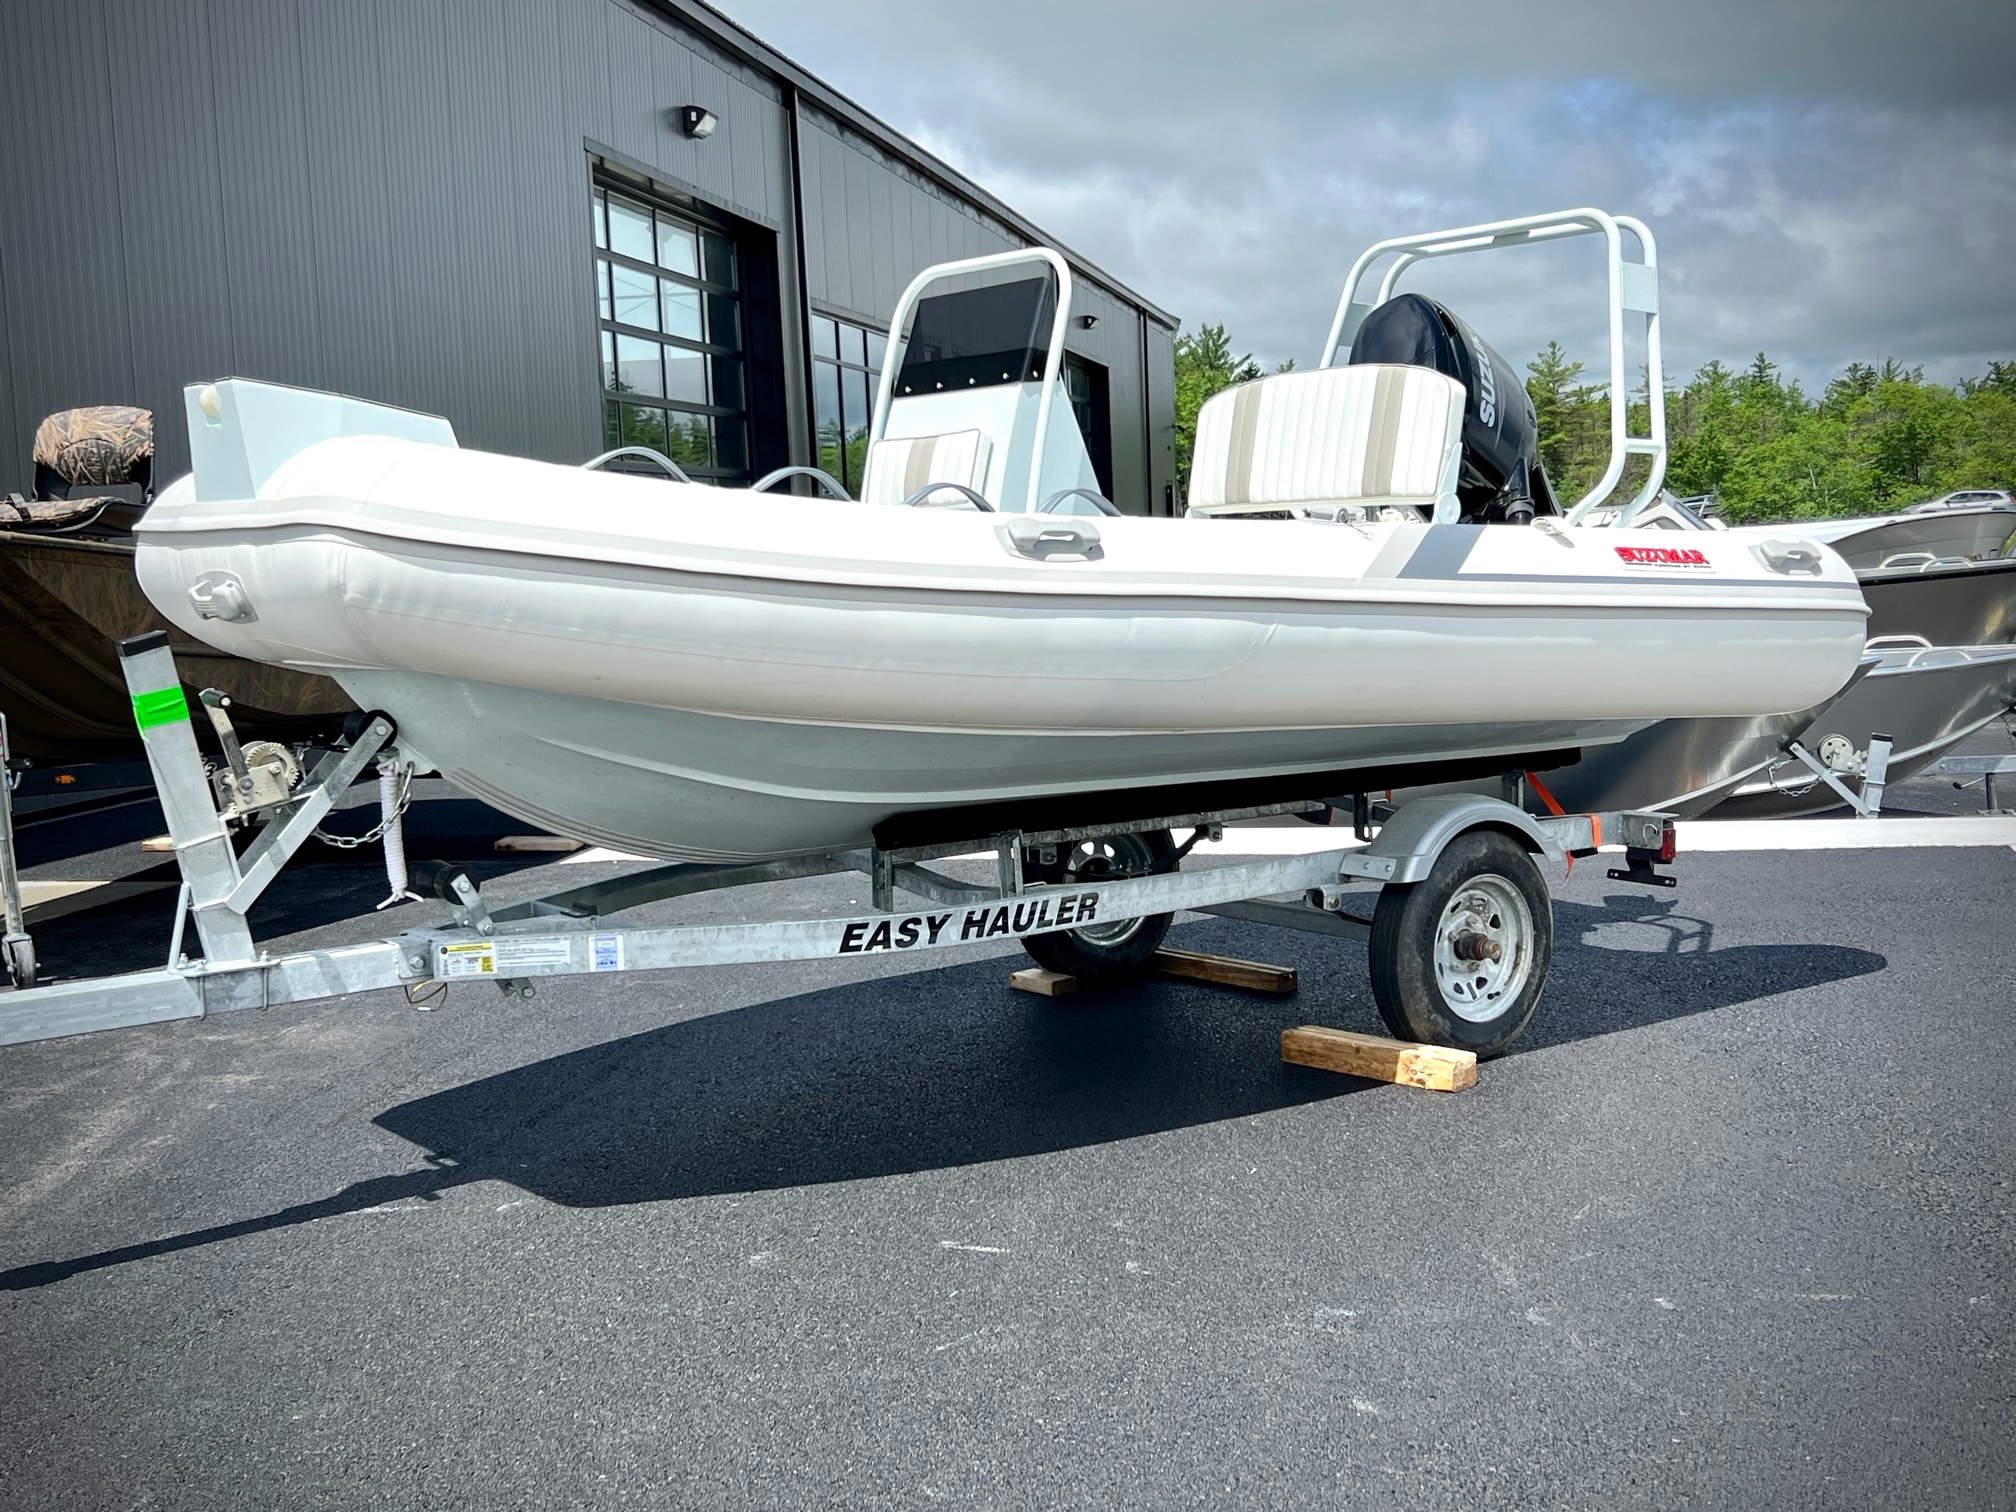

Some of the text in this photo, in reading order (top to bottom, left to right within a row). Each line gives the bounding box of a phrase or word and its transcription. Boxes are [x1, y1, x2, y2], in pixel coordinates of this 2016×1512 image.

[1614, 547, 1710, 564] SUZUMAR
[838, 892, 1099, 953] EASY HAULER
